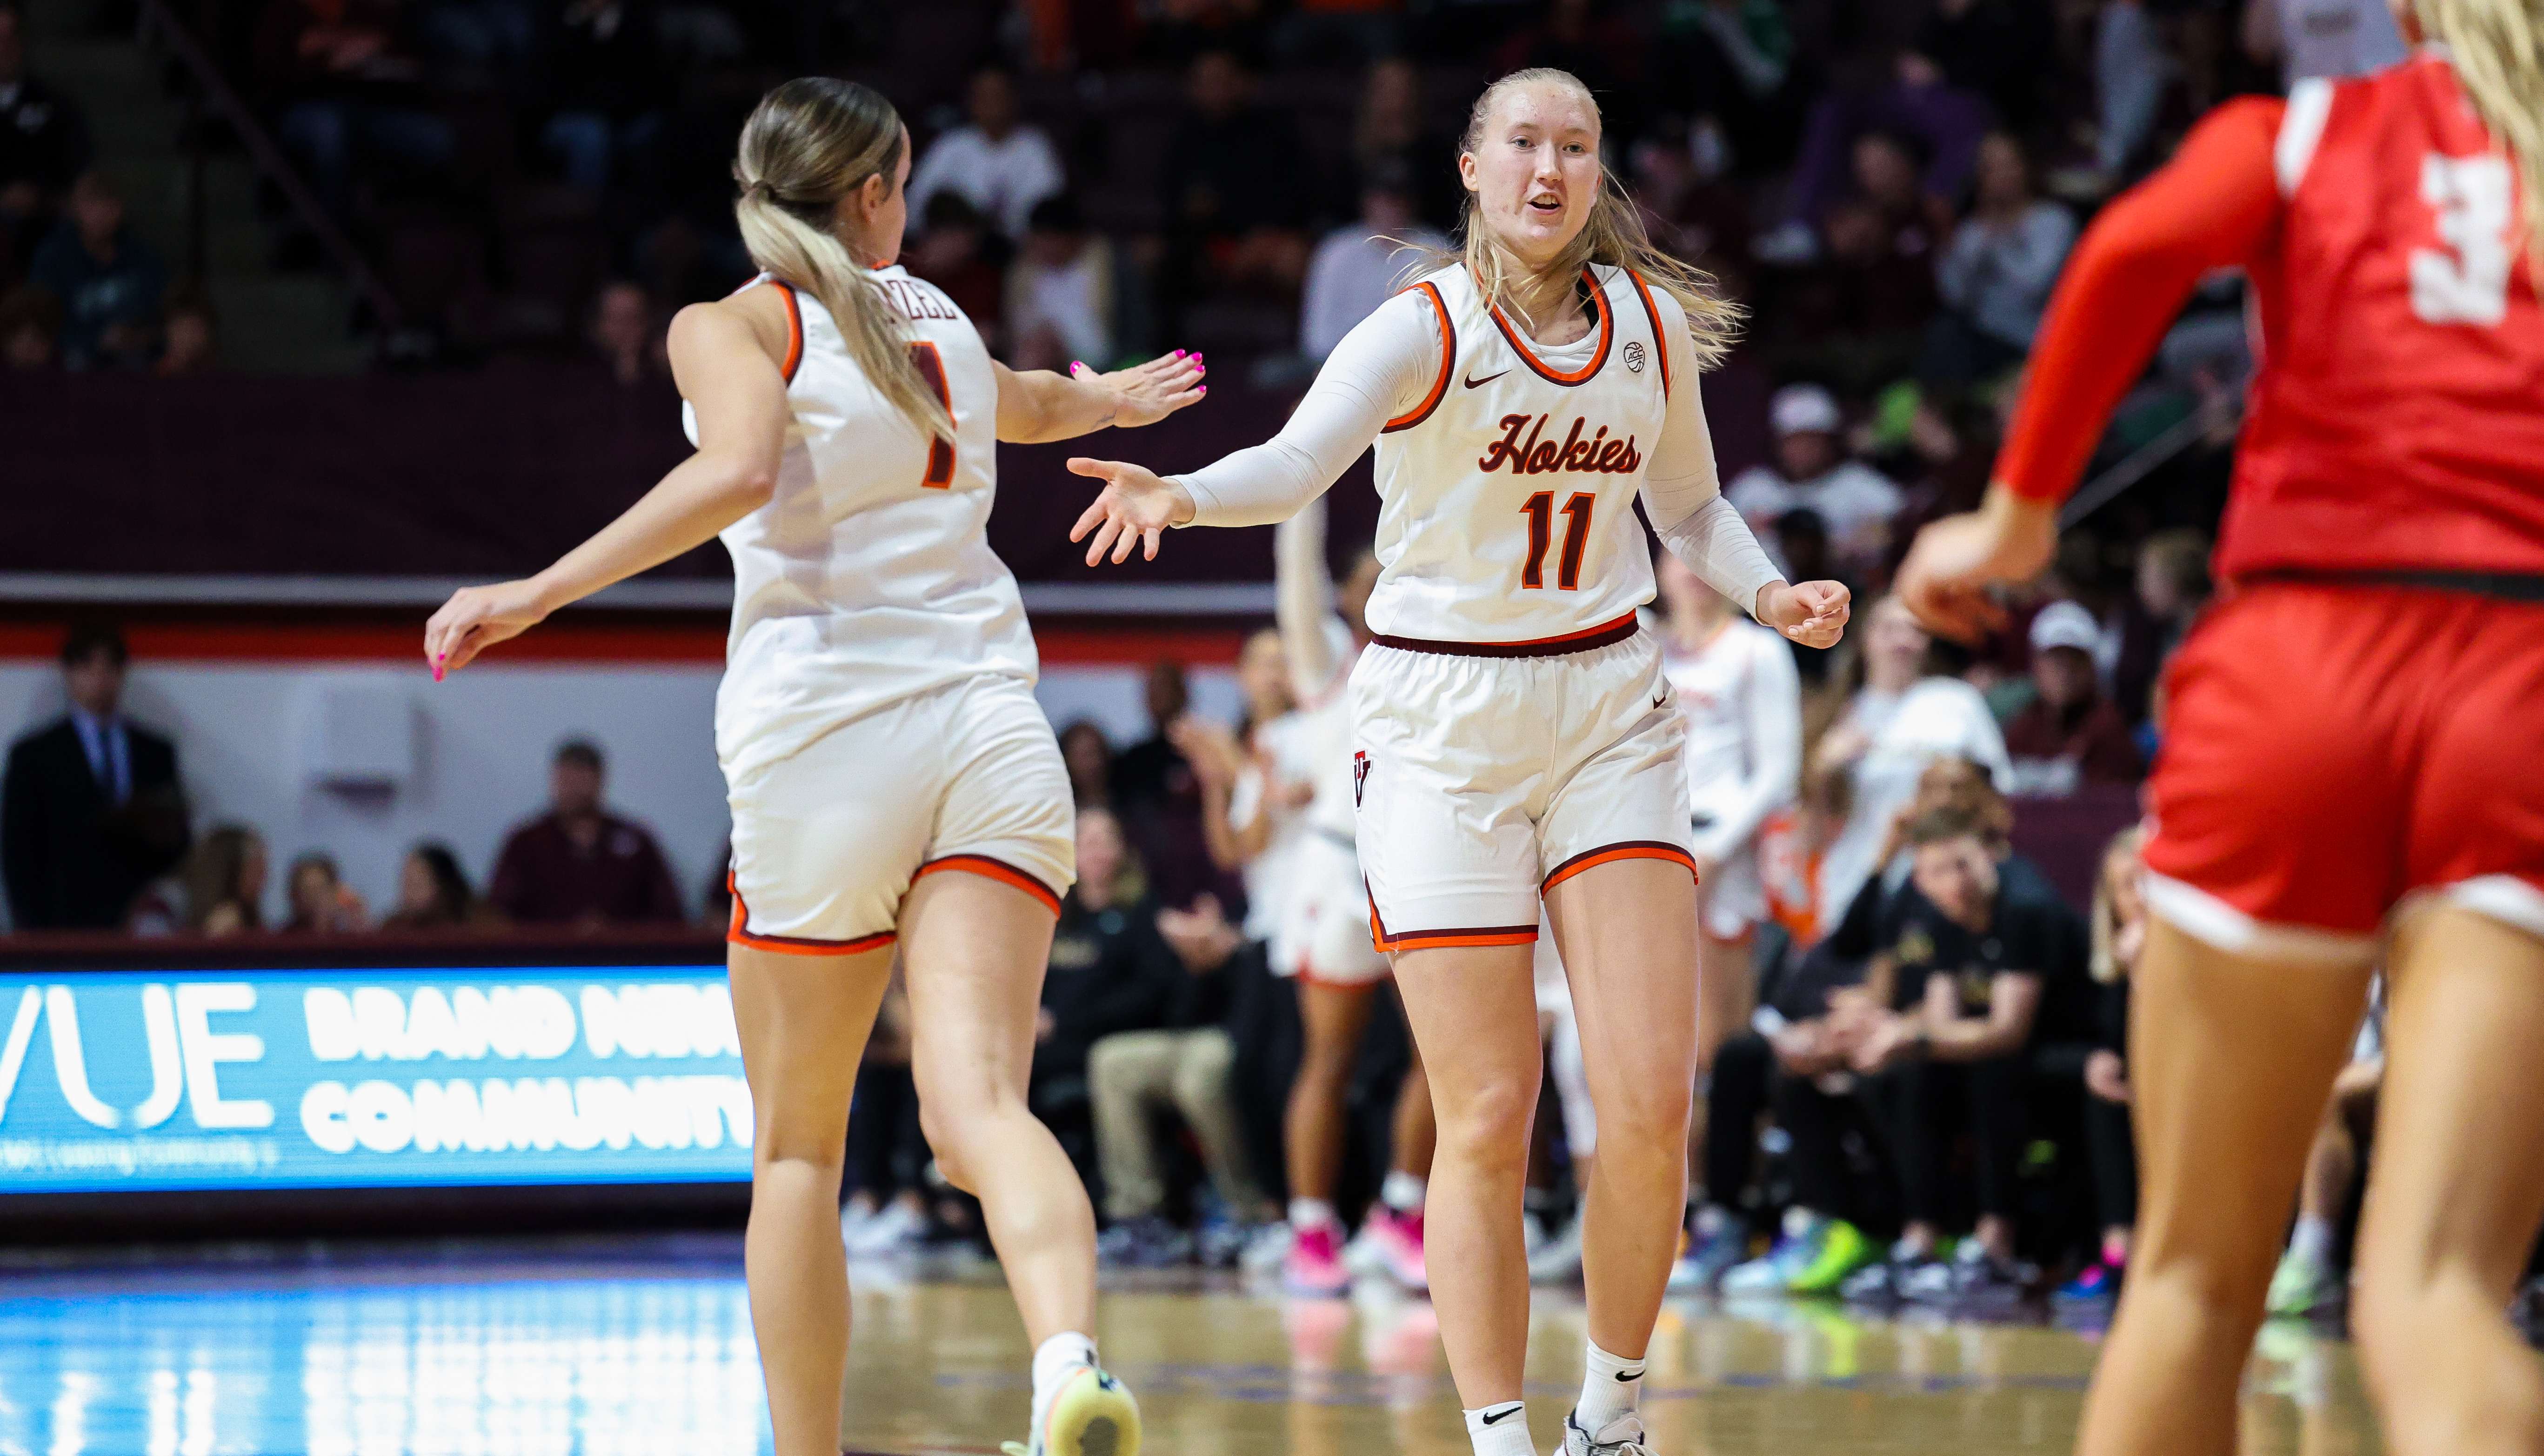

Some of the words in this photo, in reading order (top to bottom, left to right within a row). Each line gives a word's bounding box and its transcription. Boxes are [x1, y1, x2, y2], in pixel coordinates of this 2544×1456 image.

[1478, 413, 1642, 474] Hokies
[1518, 490, 1596, 591] 11
[303, 984, 577, 1062] BRAND
